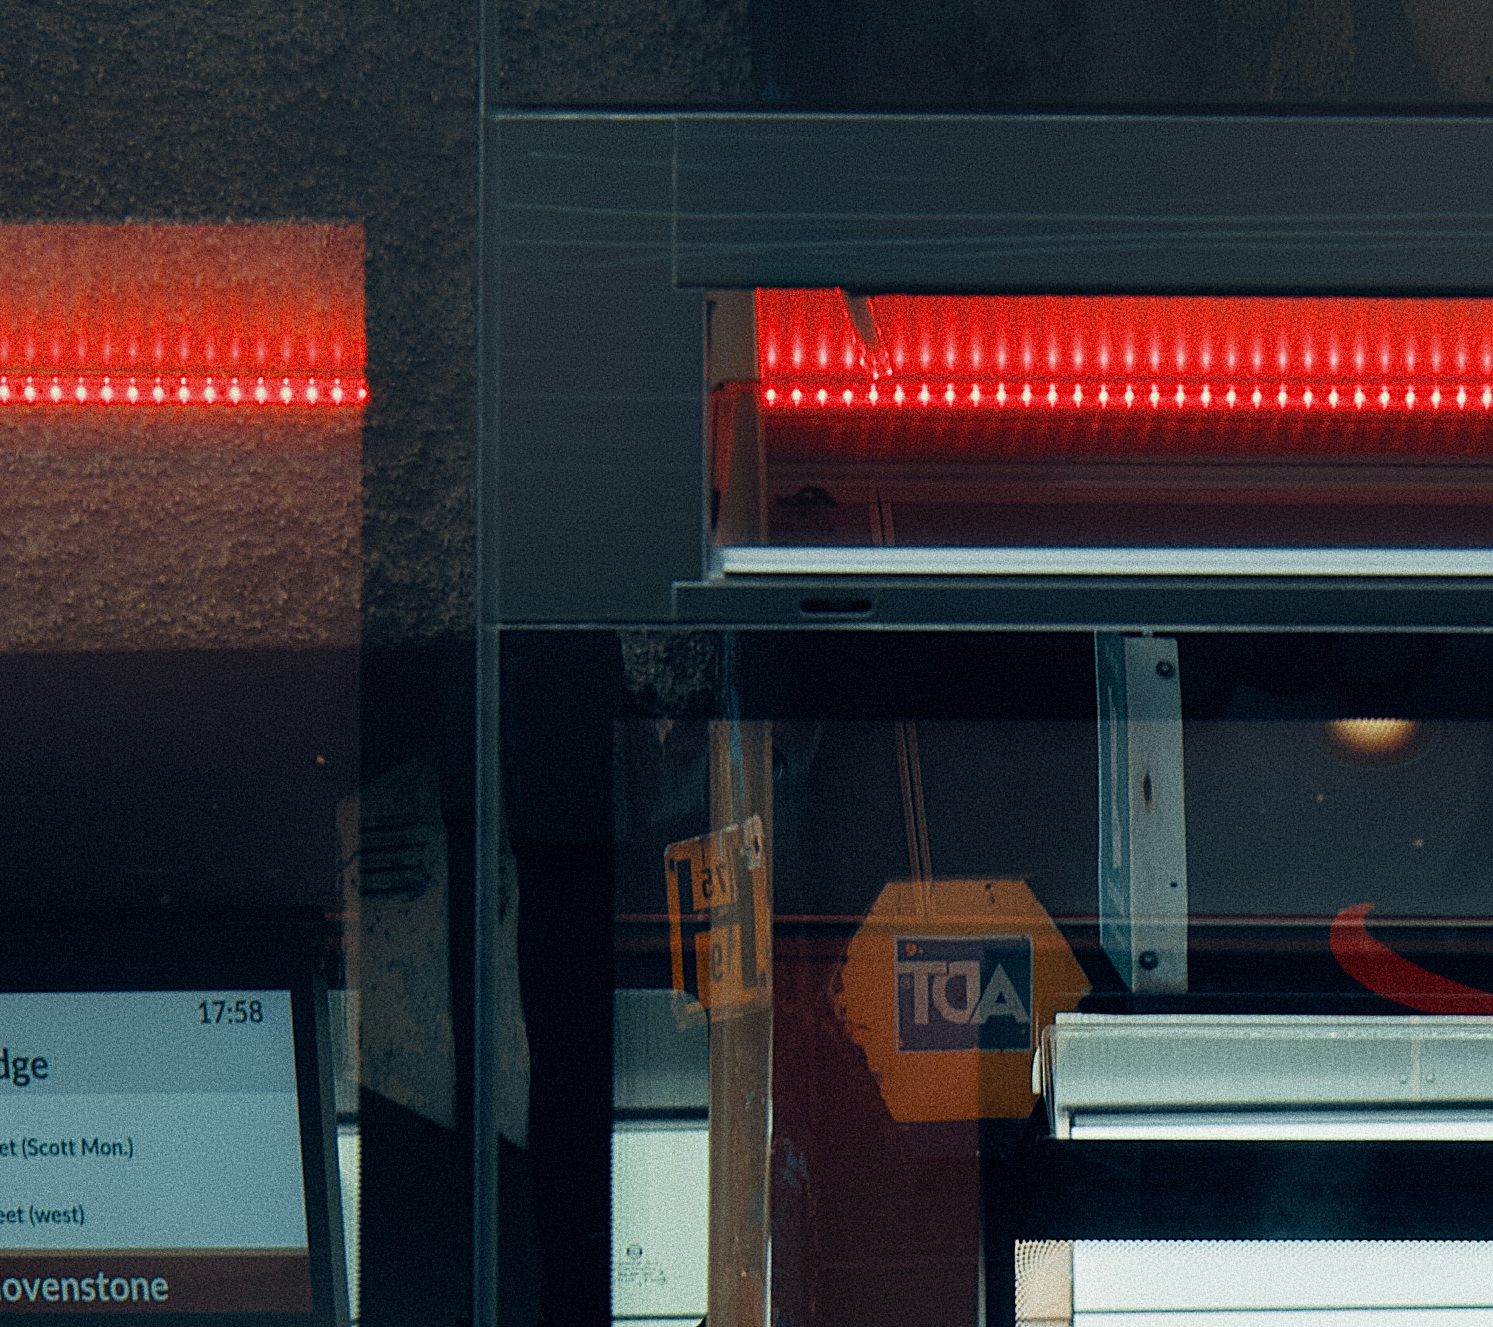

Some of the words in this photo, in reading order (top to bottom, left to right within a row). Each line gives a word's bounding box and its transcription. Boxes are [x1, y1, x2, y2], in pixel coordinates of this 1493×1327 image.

[198, 999, 264, 1025] 17:58
[21, 1136, 76, 1160] (Scott
[81, 1136, 135, 1160] Mon.)
[29, 1203, 85, 1228] (west)
